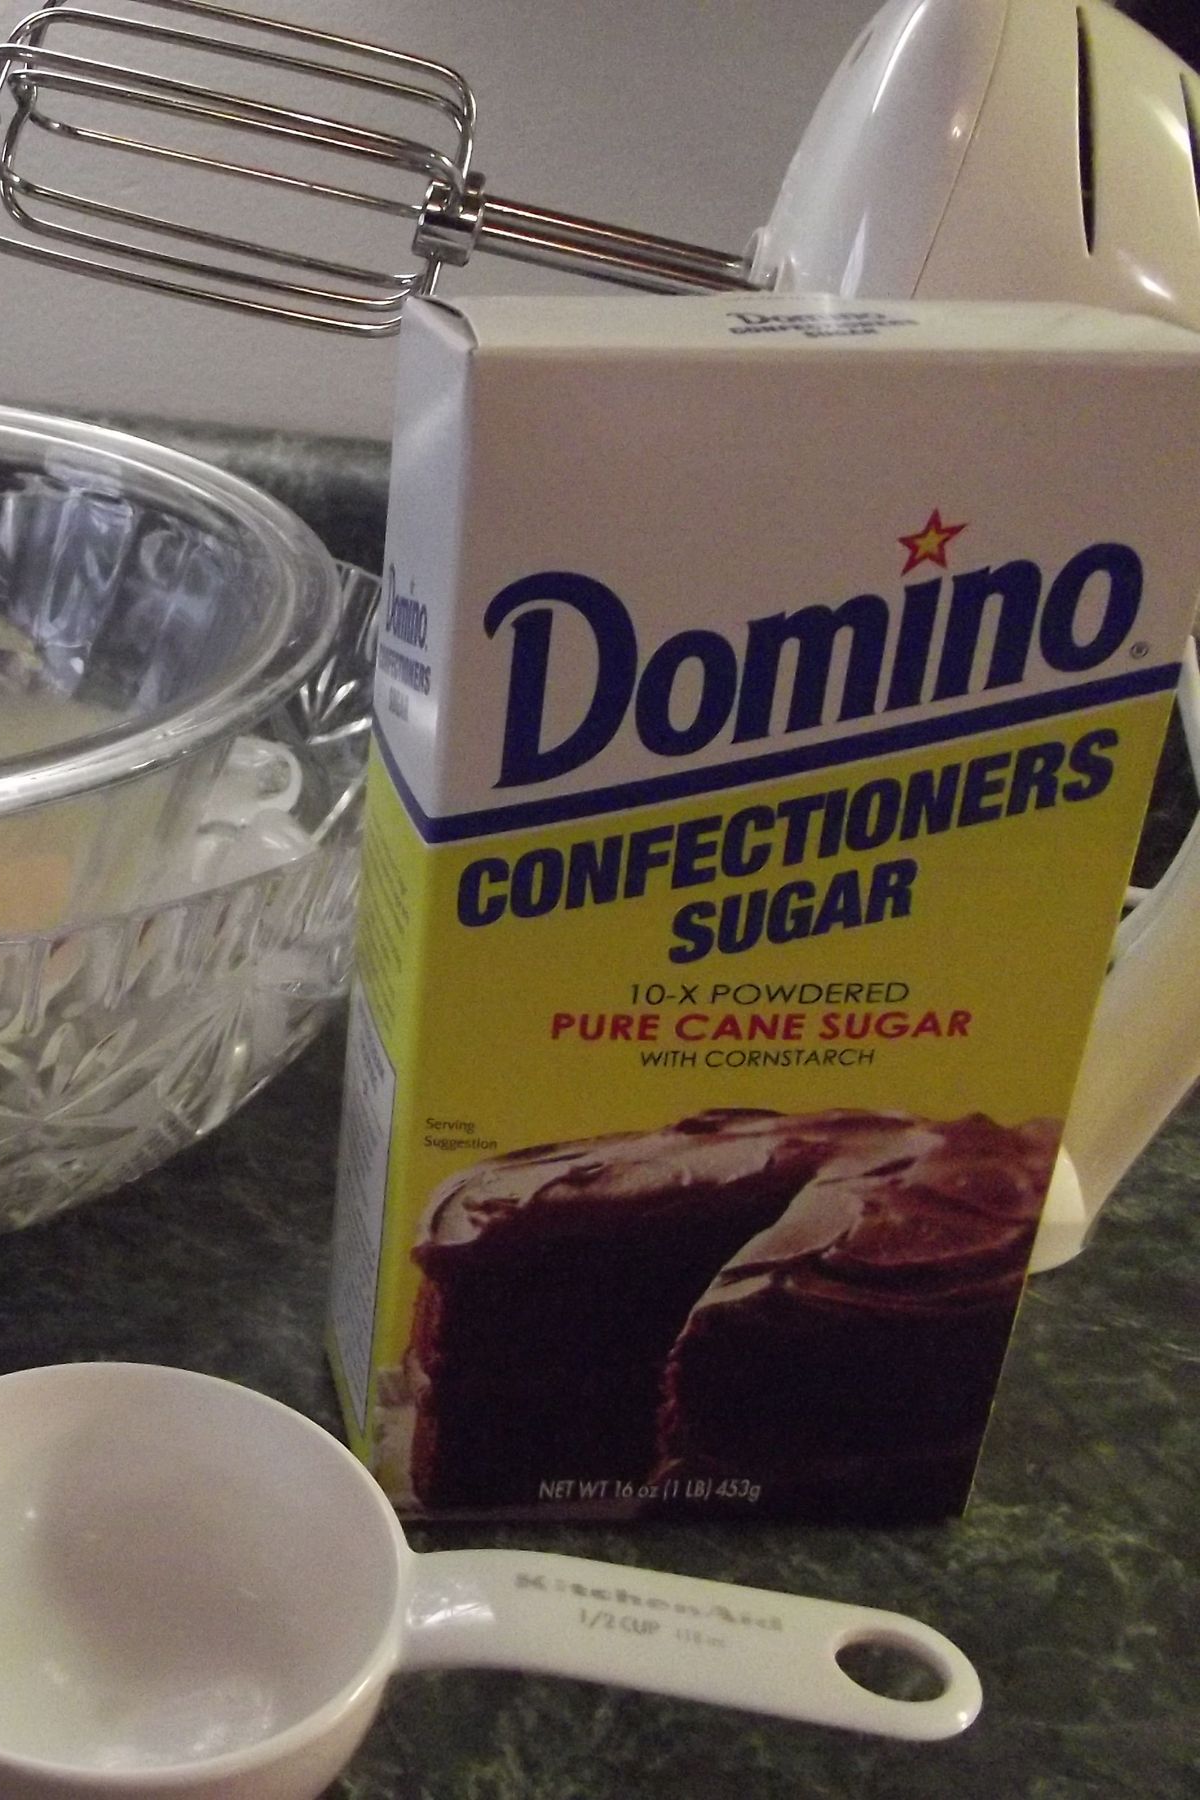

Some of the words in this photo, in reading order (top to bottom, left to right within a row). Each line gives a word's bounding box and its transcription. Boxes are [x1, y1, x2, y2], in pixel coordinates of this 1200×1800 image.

[484, 542, 1144, 789] Domino
[458, 728, 1119, 927] CONFECTIONERS
[668, 858, 918, 965] SUGAR
[631, 983, 699, 1006] 10-X
[710, 982, 910, 1005] POWDERED
[551, 1012, 661, 1042] PURE
[674, 1012, 806, 1042] CANE
[818, 1009, 973, 1041] SUGAR
[640, 1051, 697, 1068] WITH
[704, 1048, 876, 1068] CORNSTARCH
[426, 1117, 475, 1134] Serving
[423, 1135, 497, 1151] Suggestion
[538, 1480, 573, 1498] NET
[579, 1480, 609, 1498] WT
[614, 1480, 633, 1498] 16
[638, 1486, 660, 1498] oz
[685, 1479, 713, 1500] LB)
[715, 1479, 762, 1502] 453g
[619, 1614, 661, 1635] CUP
